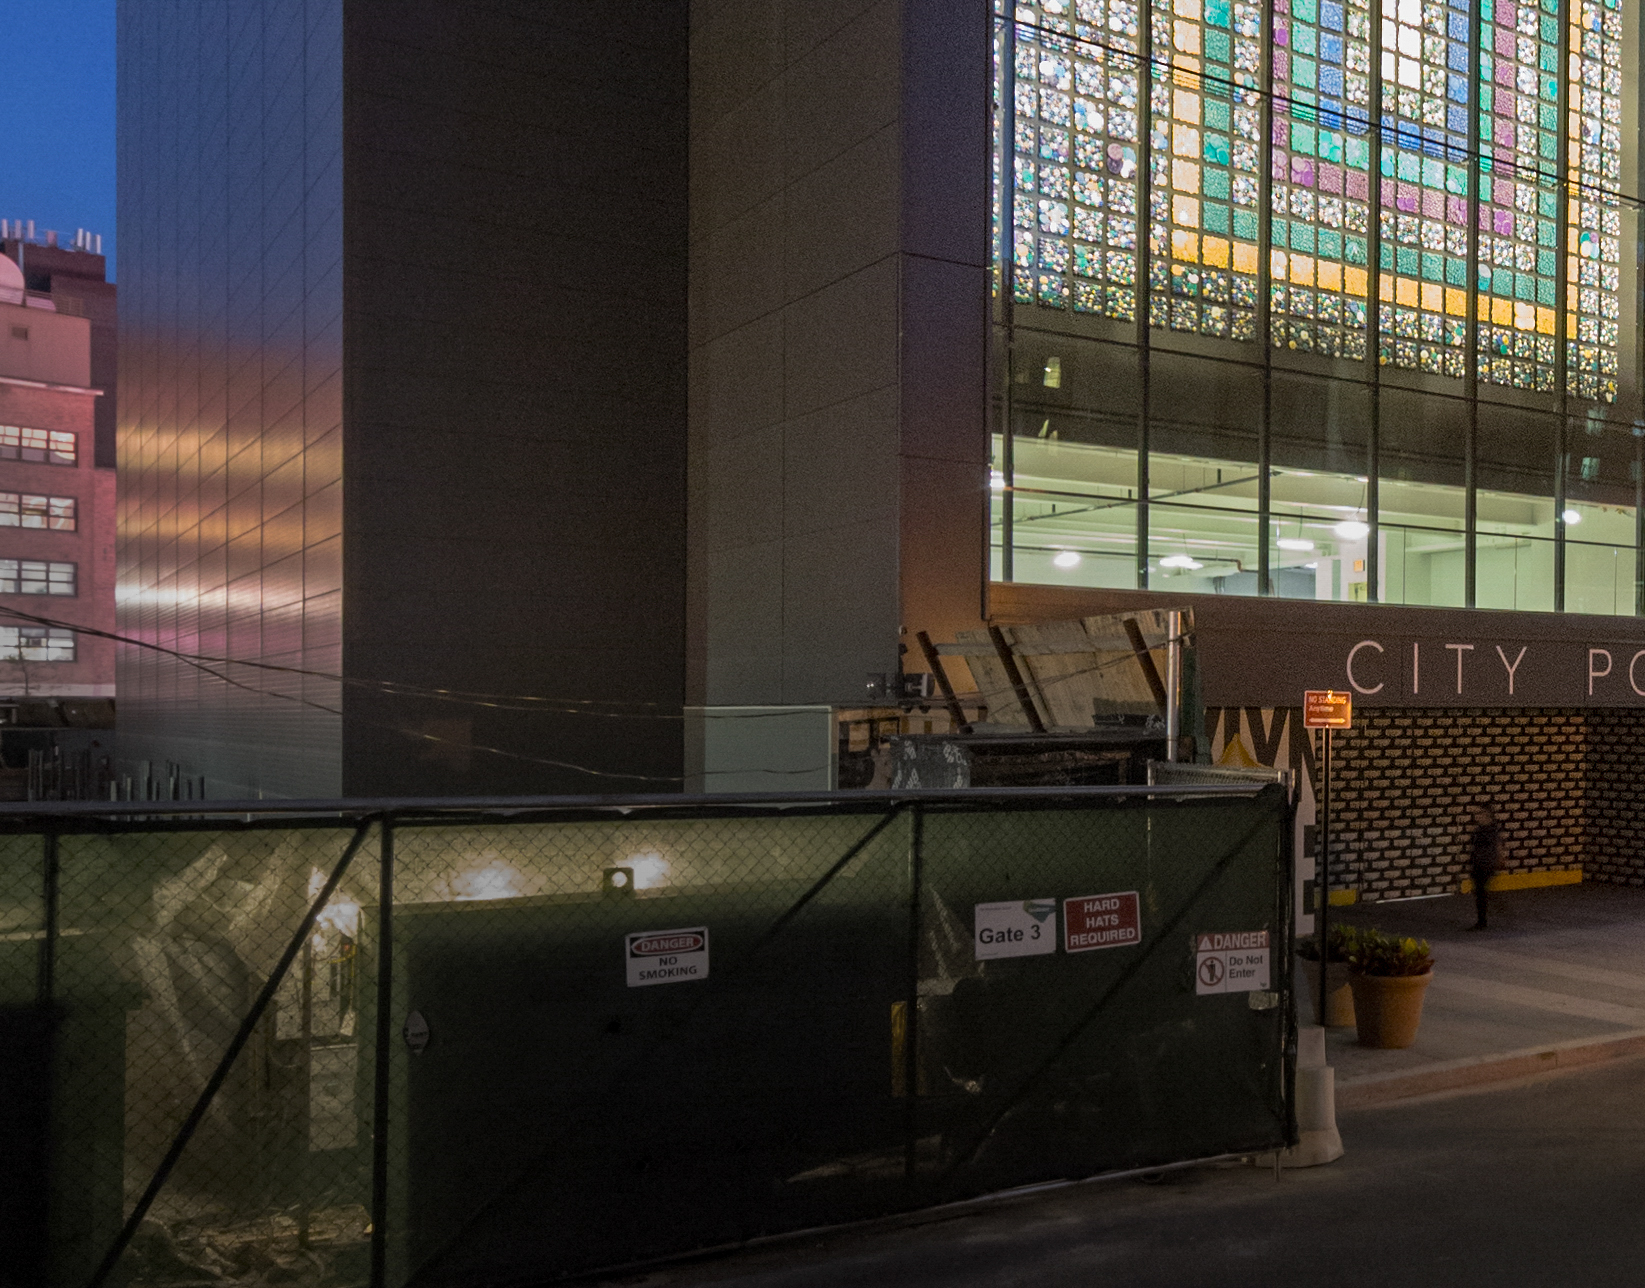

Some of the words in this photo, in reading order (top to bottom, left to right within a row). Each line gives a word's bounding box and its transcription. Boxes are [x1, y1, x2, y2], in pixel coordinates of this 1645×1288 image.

[1346, 640, 1528, 695] CITY
[1308, 695, 1318, 703] NO
[1084, 898, 1120, 913] HARD
[1085, 914, 1120, 929] HATS
[979, 927, 1024, 944] Gate
[1030, 924, 1041, 940] 3
[1070, 927, 1135, 947] REQUIRED
[1214, 932, 1266, 950] DANGER
[641, 937, 694, 952] DANGER
[659, 956, 678, 967] NO
[1229, 956, 1243, 966] Do
[1246, 955, 1263, 965] Not
[638, 965, 697, 980] SMOKING
[1229, 968, 1256, 979] Enter
